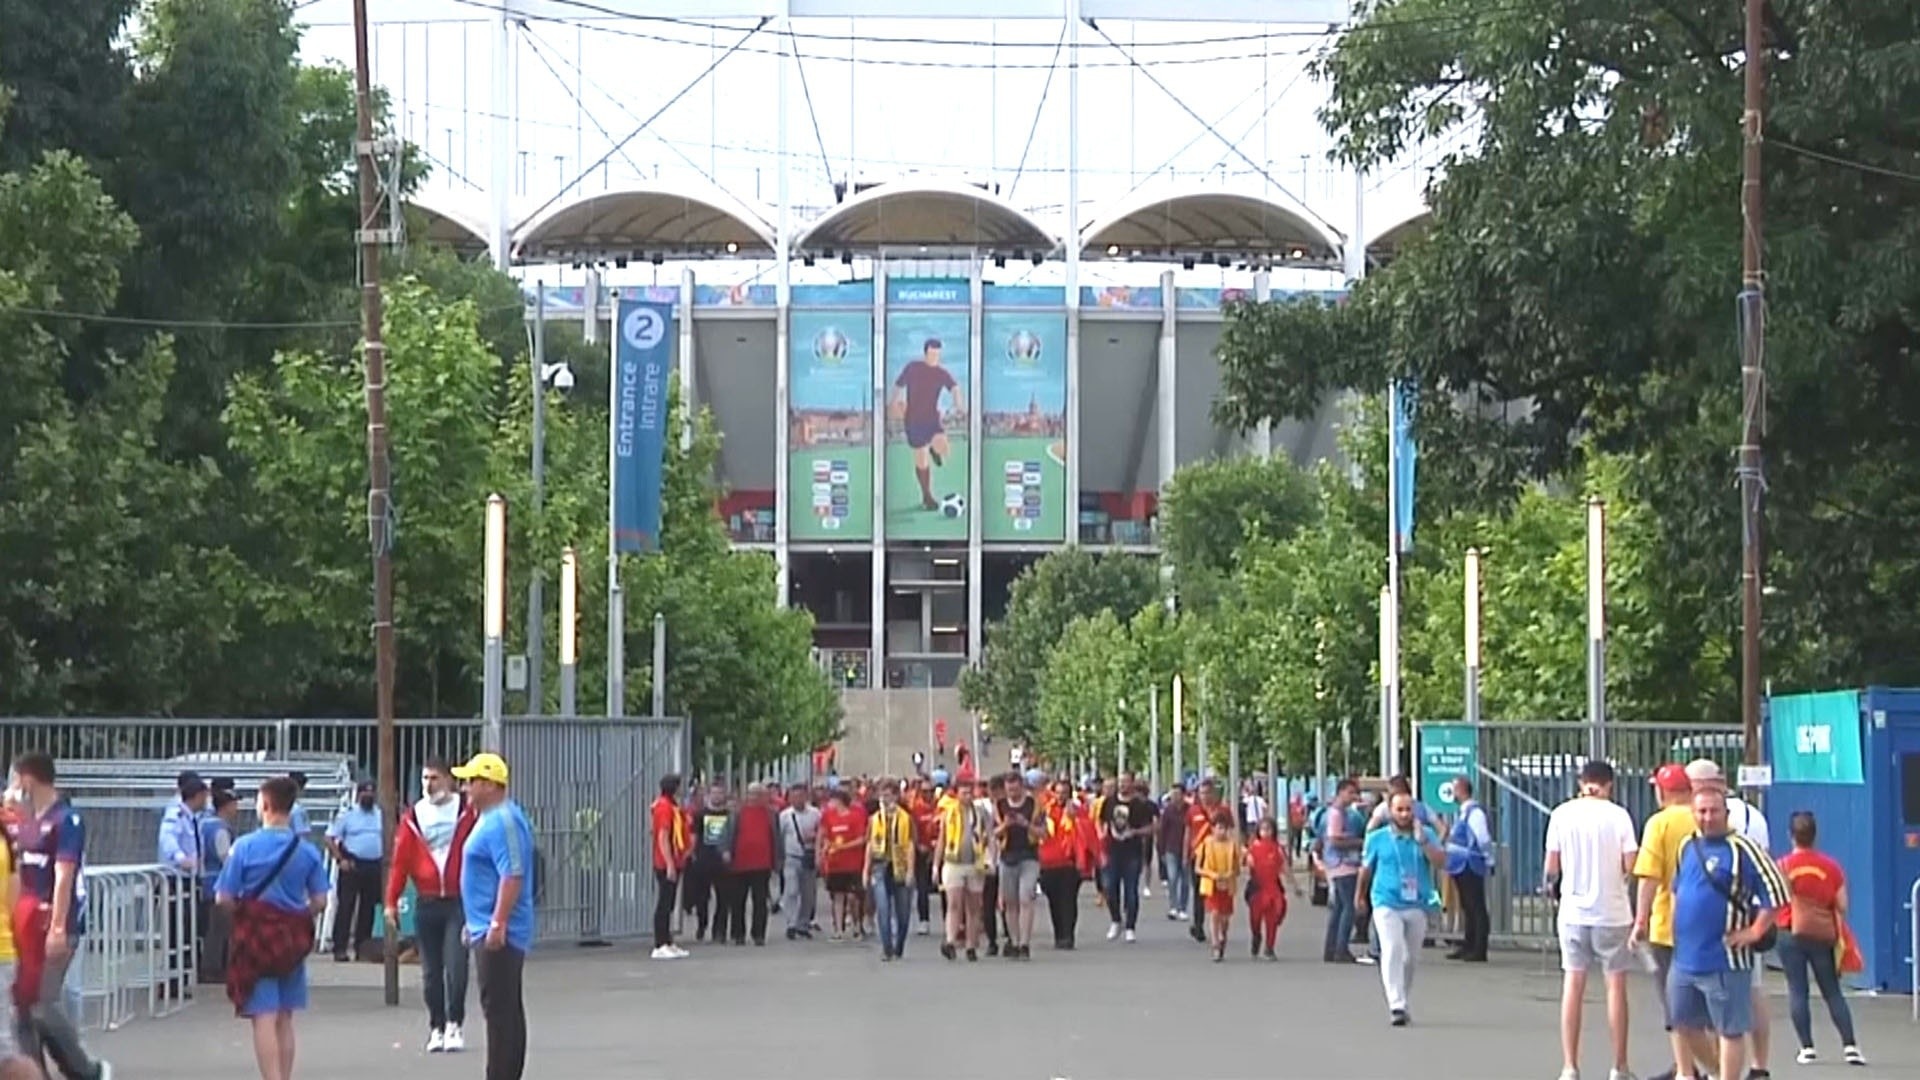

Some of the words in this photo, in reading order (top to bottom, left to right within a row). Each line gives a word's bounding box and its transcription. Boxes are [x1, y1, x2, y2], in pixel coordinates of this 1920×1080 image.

[898, 288, 957, 300] BUCHAREST
[634, 314, 654, 341] 2
[617, 360, 638, 458] Entrance
[639, 362, 661, 430] Intrare
